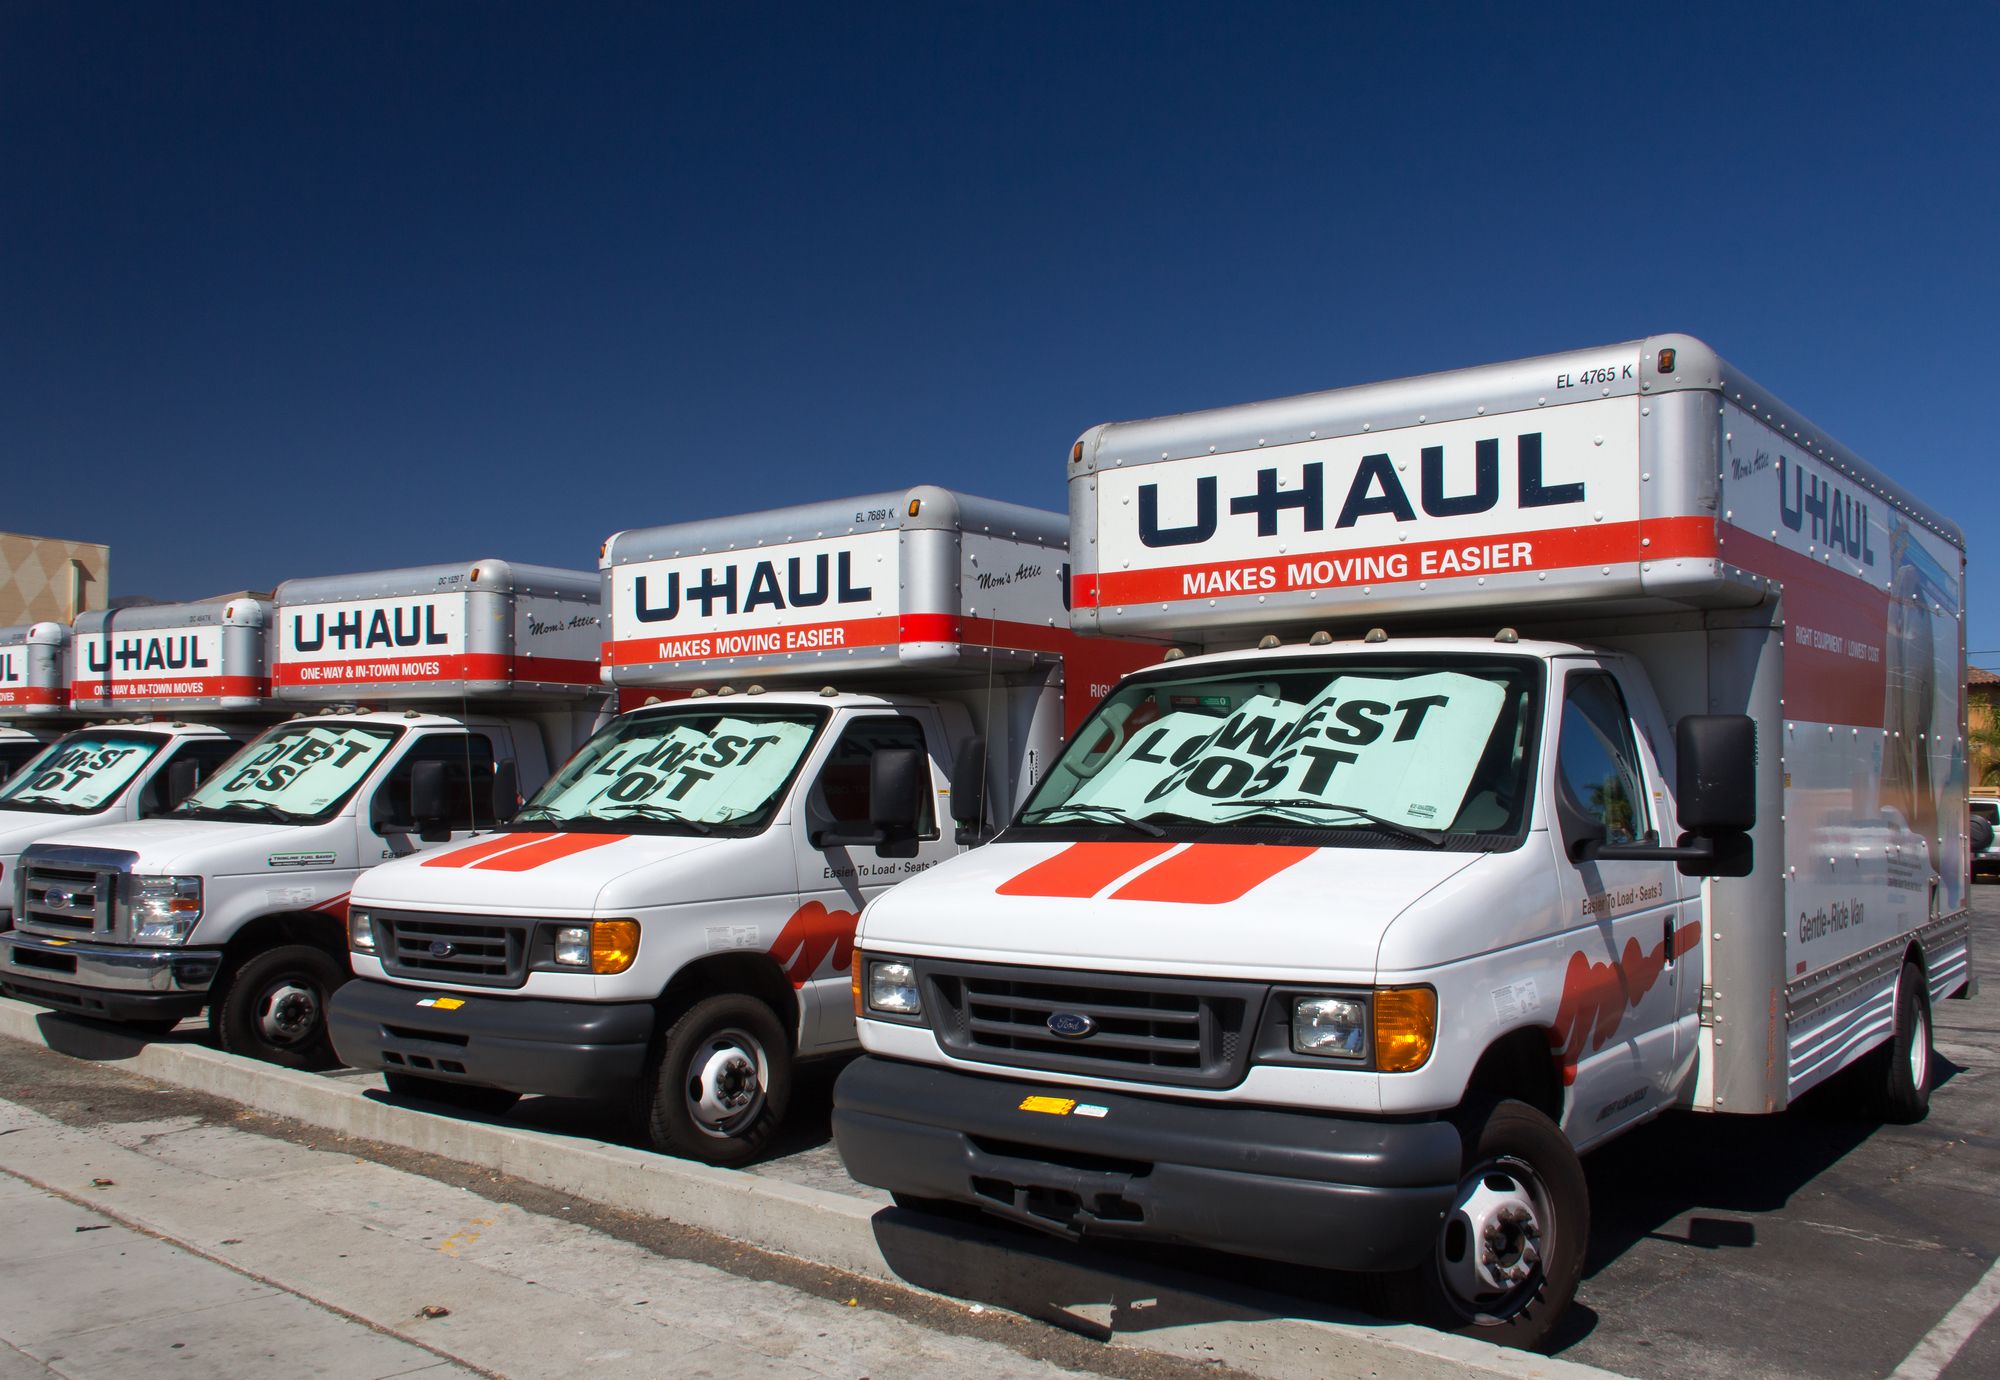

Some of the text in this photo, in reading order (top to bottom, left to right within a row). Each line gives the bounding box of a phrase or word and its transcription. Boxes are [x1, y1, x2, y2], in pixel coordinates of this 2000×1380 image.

[1556, 364, 1632, 389] EL 4765 K
[1731, 448, 1769, 481] Mom's Attic
[1137, 431, 1586, 548] U-HAUL
[855, 508, 895, 523] EL 7689 K
[1779, 454, 1874, 567] U-HAUL
[977, 563, 1042, 590] Mom's Attic
[1182, 541, 1534, 595] MAKES MOVING EASIER
[635, 550, 872, 623] U-HAUL
[295, 604, 448, 652] U-HAUL
[529, 615, 596, 636] Mom's Attic
[658, 627, 845, 659] MAKES MOVING EASIER
[88, 635, 208, 672] U-HAUL
[1795, 625, 1813, 646] RIGHT
[1813, 630, 1843, 654] EQUIPMENT
[1848, 640, 1867, 660] LOWEST
[1867, 645, 1880, 663] COST
[300, 661, 440, 680] ONE-WAY & IN-TOWN MOVES
[94, 681, 204, 696] ONE-WAY & IN-TOWN MOVES
[1128, 694, 1450, 768] LOWEST
[1143, 744, 1360, 804] COST
[823, 867, 855, 879] Easier
[857, 865, 869, 876] To
[872, 863, 896, 875] Load
[904, 861, 930, 873] Seats
[1582, 882, 1663, 915] Easier To Load Seats 3
[1800, 897, 1864, 944] Gentle-Ride Van
